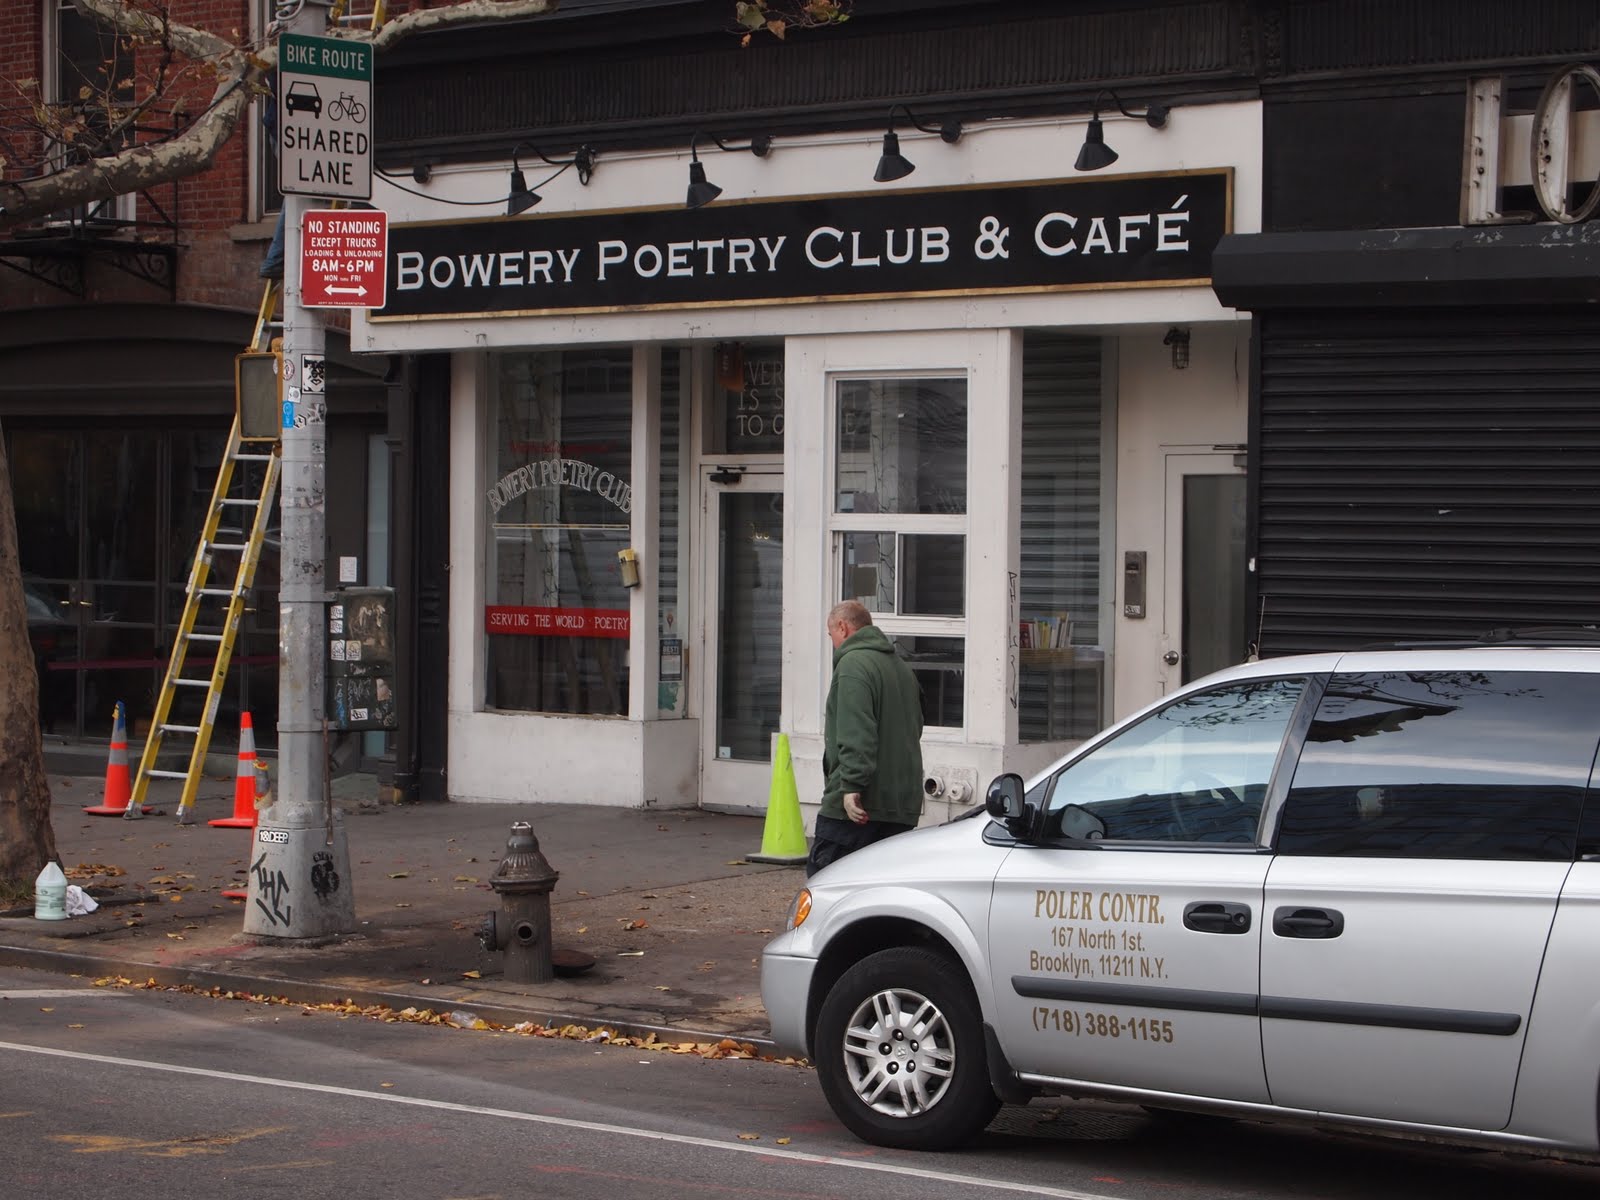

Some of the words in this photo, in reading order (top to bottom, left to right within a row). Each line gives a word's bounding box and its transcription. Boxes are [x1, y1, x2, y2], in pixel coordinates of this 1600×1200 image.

[287, 44, 316, 65] BIKE
[322, 48, 365, 71] ROUTE
[284, 125, 368, 155] SHARED
[299, 158, 353, 185] LANE
[308, 221, 323, 234] NO
[328, 221, 381, 234] STANDING
[305, 249, 334, 257] LOADING
[344, 250, 383, 258] UNLOADING
[311, 237, 341, 247] EXCEPT
[346, 237, 377, 248] TRUCKS
[396, 248, 581, 290] BOWERY
[597, 235, 787, 281] POETRY
[804, 225, 950, 269] CLUB
[974, 215, 1009, 260] &
[1034, 194, 1190, 257] CAFÉ
[312, 259, 374, 273] 8AM-6PM
[323, 274, 338, 282] MON
[350, 274, 362, 282] FRI
[736, 414, 763, 436] TO
[487, 463, 538, 514] BOWERY
[540, 459, 599, 492] POETRY
[596, 471, 632, 514] CLUB
[490, 613, 529, 626] SERVING
[534, 614, 551, 628] THE
[555, 615, 585, 629] WORLD
[594, 616, 629, 630] POETRY
[1034, 889, 1093, 921] POLER
[1099, 892, 1165, 924] CONTR.
[1051, 926, 1074, 947] 167
[1078, 927, 1116, 950] North
[1121, 930, 1145, 952] 1st.
[1030, 950, 1094, 979] Brooklyn,
[1099, 954, 1134, 977] 11211
[1140, 957, 1168, 979] N.Y.
[1032, 1006, 1081, 1037] (718)
[1084, 1012, 1174, 1044] 388-1155
